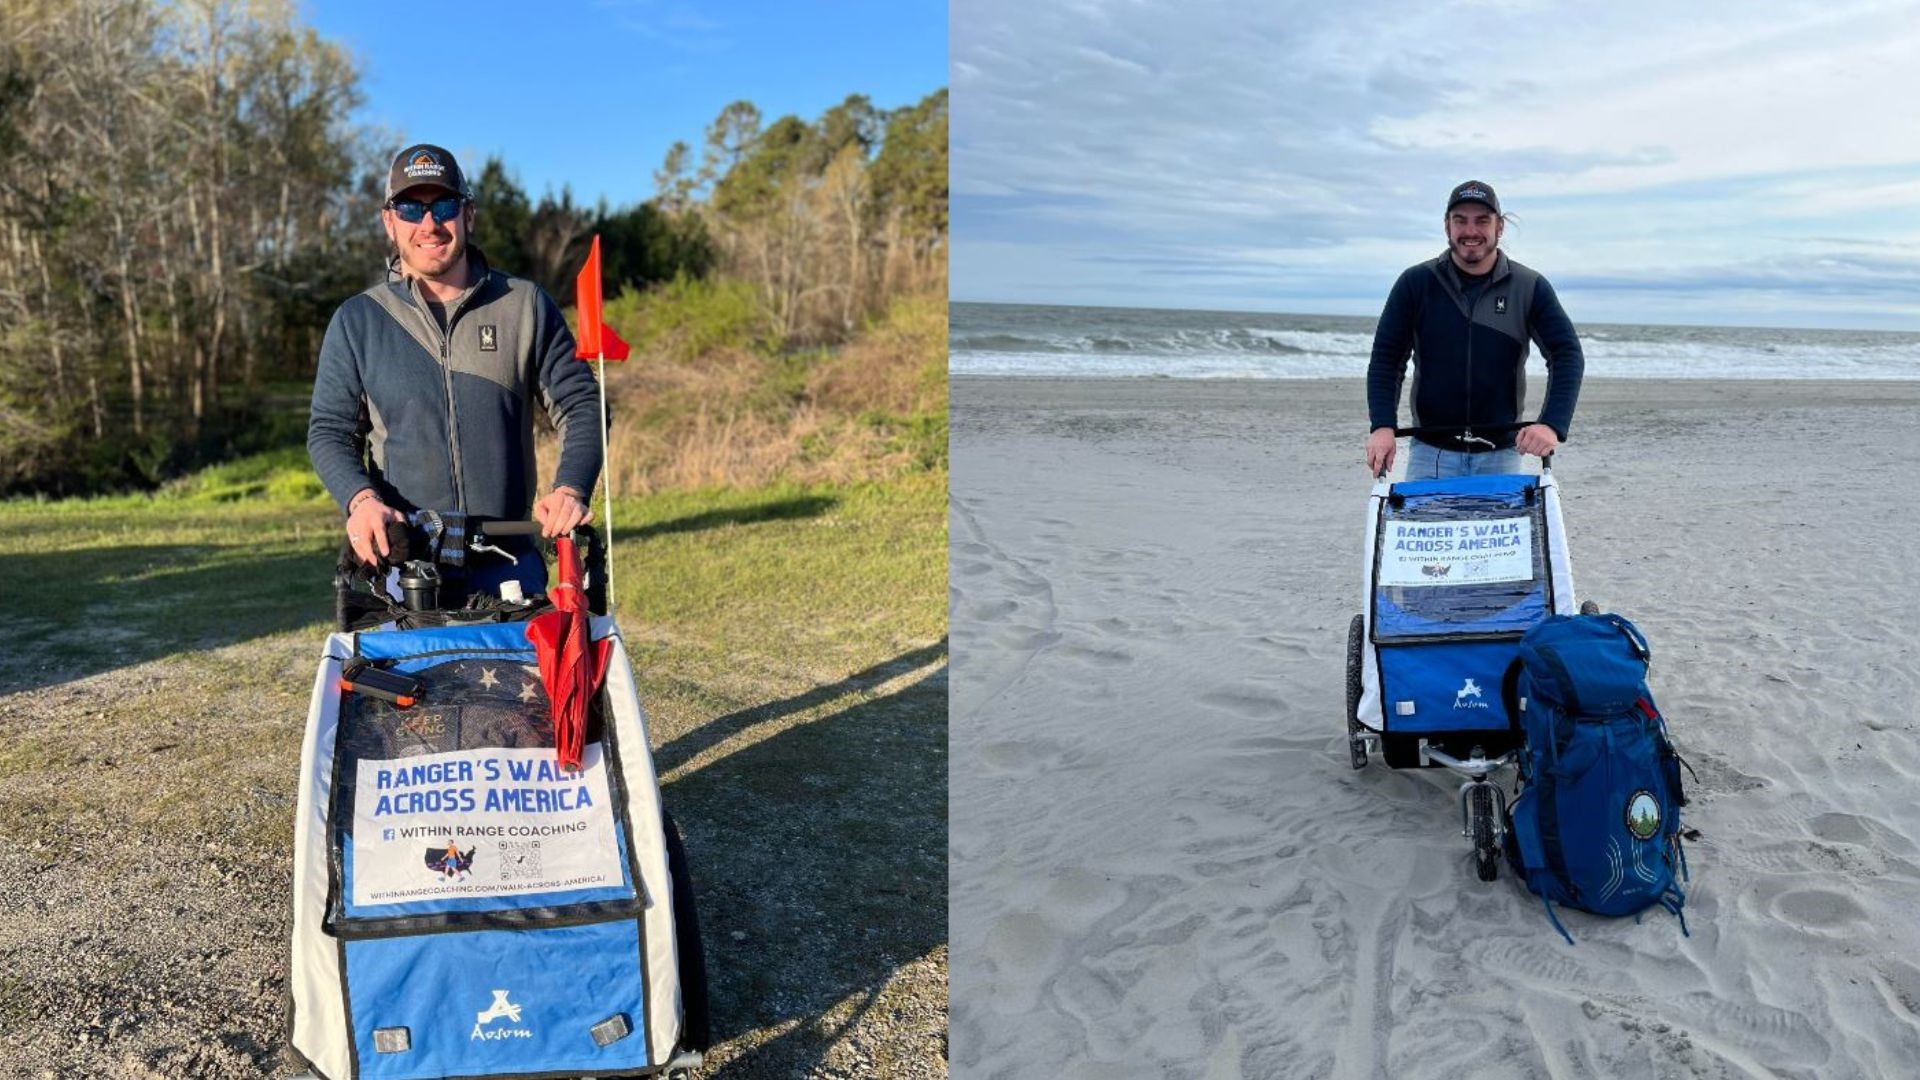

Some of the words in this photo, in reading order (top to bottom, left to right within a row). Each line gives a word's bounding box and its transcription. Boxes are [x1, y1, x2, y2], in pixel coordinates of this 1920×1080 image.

[1397, 526, 1469, 537] RANGER'S
[1474, 523, 1519, 535] WALK
[1395, 539, 1453, 551] ACROSS
[1458, 535, 1521, 550] AMERICA
[377, 759, 500, 789] RANGER'S
[374, 788, 476, 816] ACROSS
[484, 786, 593, 812] AMERICA
[400, 826, 452, 839] WITHIN
[456, 825, 505, 837] RANGE
[509, 821, 587, 837] COACHING
[471, 1024, 532, 1041] Aosom
